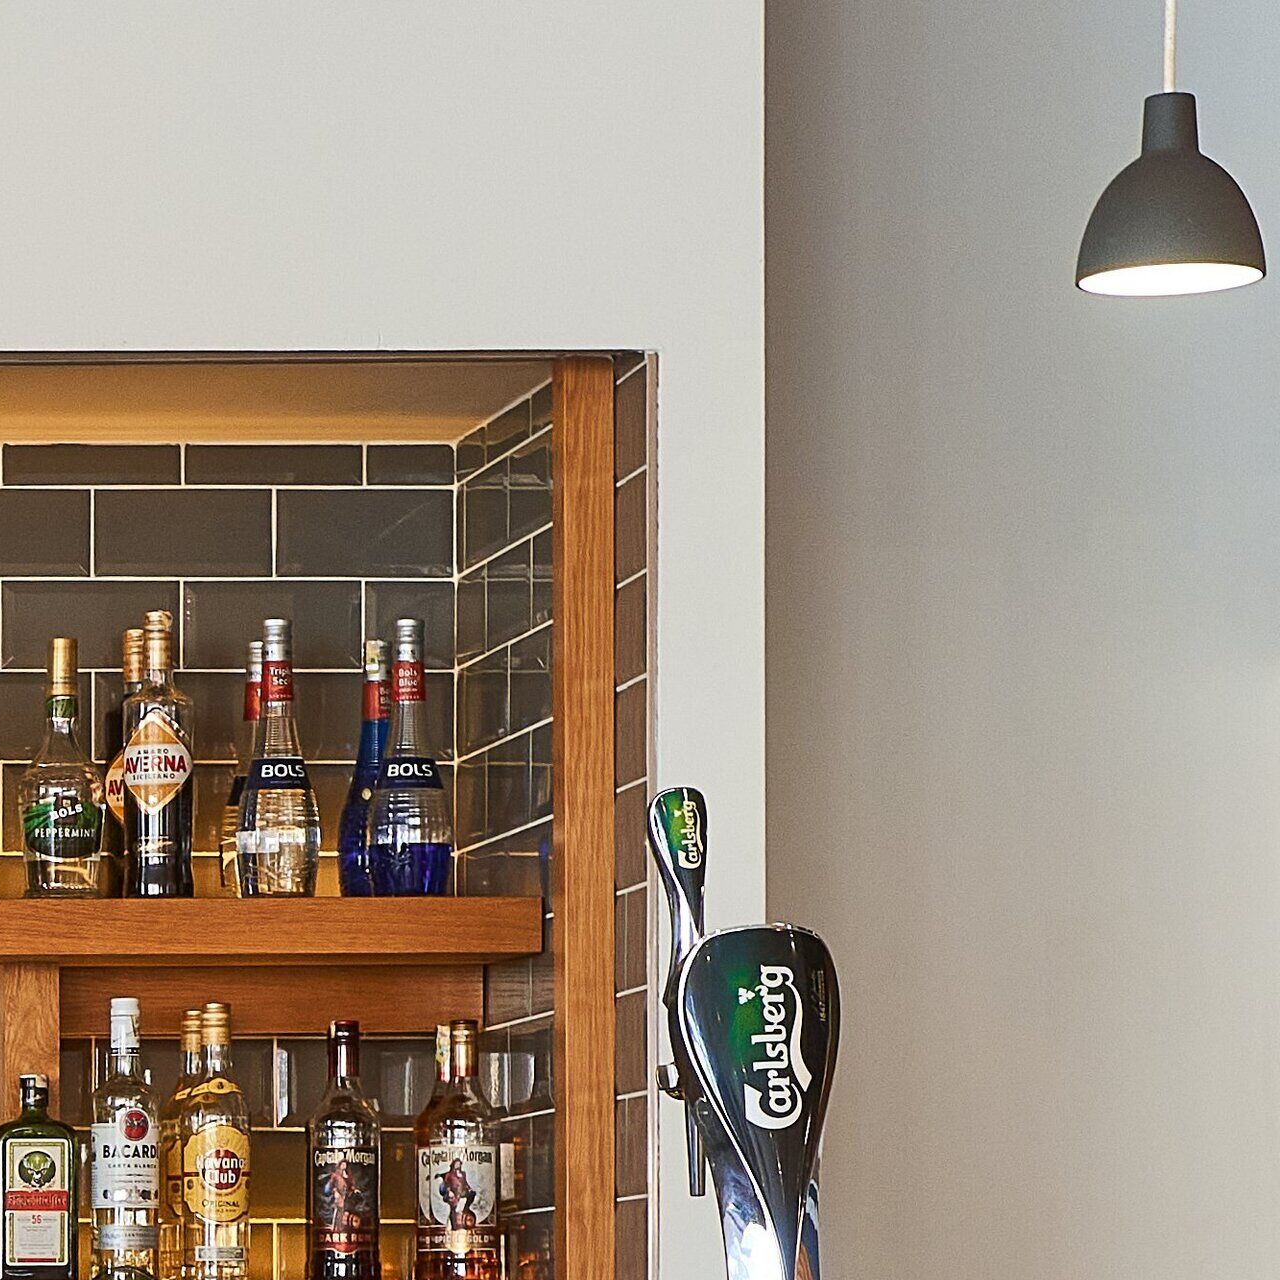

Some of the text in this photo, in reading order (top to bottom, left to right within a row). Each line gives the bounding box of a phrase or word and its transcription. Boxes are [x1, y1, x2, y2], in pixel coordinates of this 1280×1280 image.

[125, 755, 187, 775] AVERNA
[261, 763, 306, 778] BOLS
[387, 763, 433, 778] BOLS
[49, 803, 84, 822] BOLS
[35, 827, 95, 838] PEPPERMINT
[678, 798, 703, 869] Carlsberg
[744, 964, 806, 1130] Carlsberg
[205, 1169, 236, 1184] Club
[202, 1199, 240, 1208] ORGINAL
[319, 1232, 348, 1243] DARK
